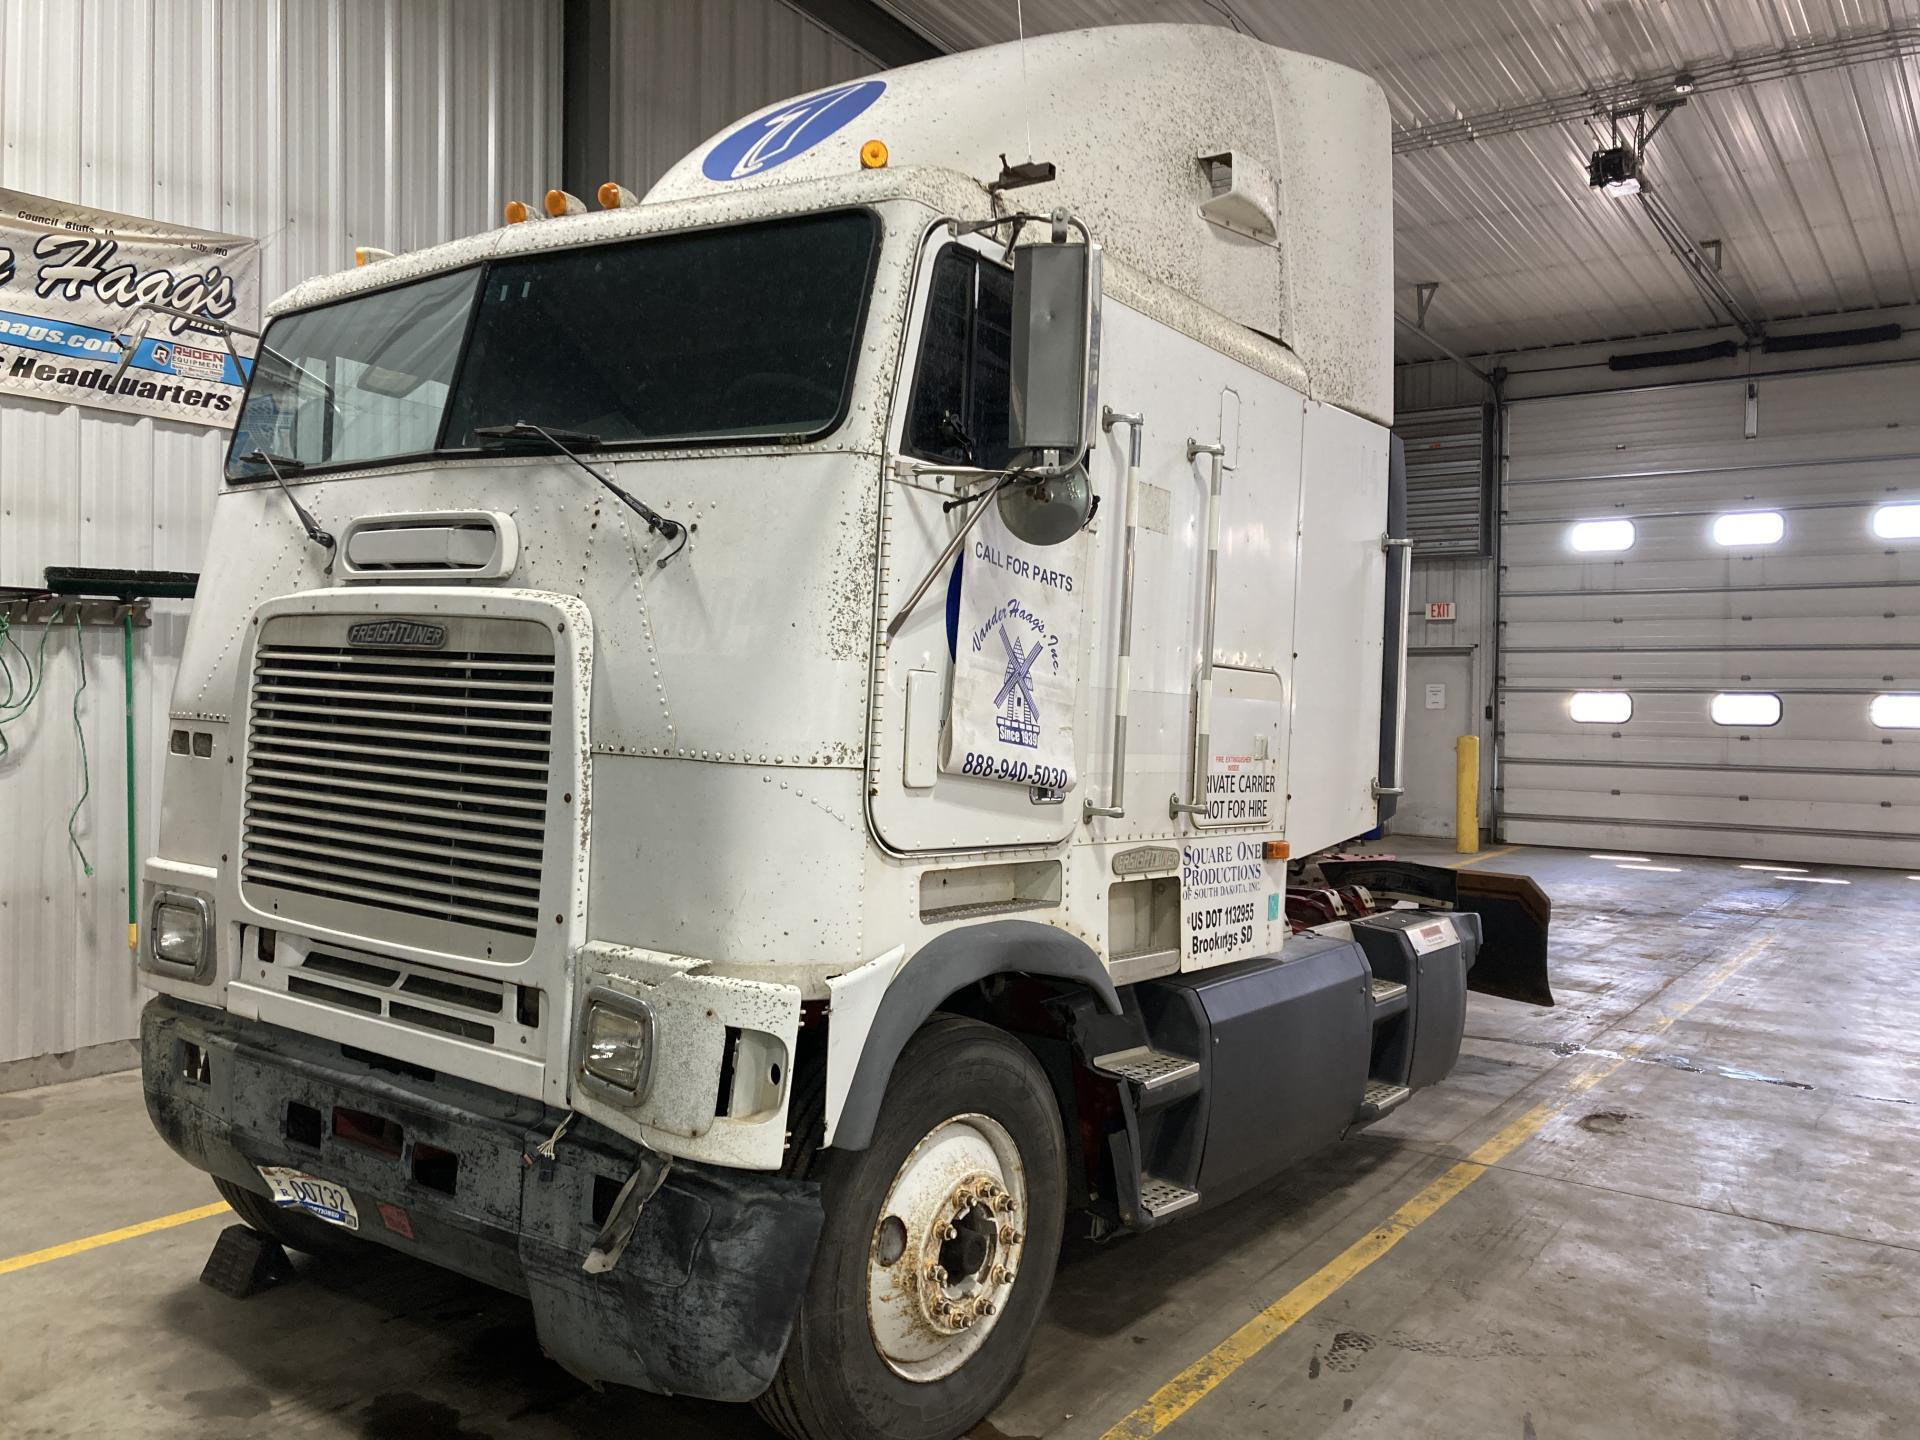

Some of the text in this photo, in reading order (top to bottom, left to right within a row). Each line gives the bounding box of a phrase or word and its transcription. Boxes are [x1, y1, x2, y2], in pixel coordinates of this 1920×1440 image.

[18, 210, 60, 227] Council
[213, 247, 228, 257] MO
[33, 232, 236, 337] Haag's
[172, 356, 224, 369] EQUIPMENT
[173, 346, 224, 363] RYDEN
[9, 356, 232, 412] Headquarters
[975, 541, 1072, 592] CALL FOR PARTS
[1431, 603, 1450, 618] EXIT
[351, 622, 443, 644] FREIGHTLINER
[1000, 725, 1038, 746] Since 1939
[962, 752, 1068, 789] 888-940-5030
[1206, 775, 1276, 793] RIVATE CARRIER
[1204, 800, 1268, 819] NOT FOR HIRE
[1183, 889, 1193, 900] OF
[1194, 887, 1219, 900] SOUTH
[1191, 902, 1254, 931] US DOT 1132955
[1192, 925, 1253, 954] Brookings SD
[289, 1180, 349, 1213] 00732
